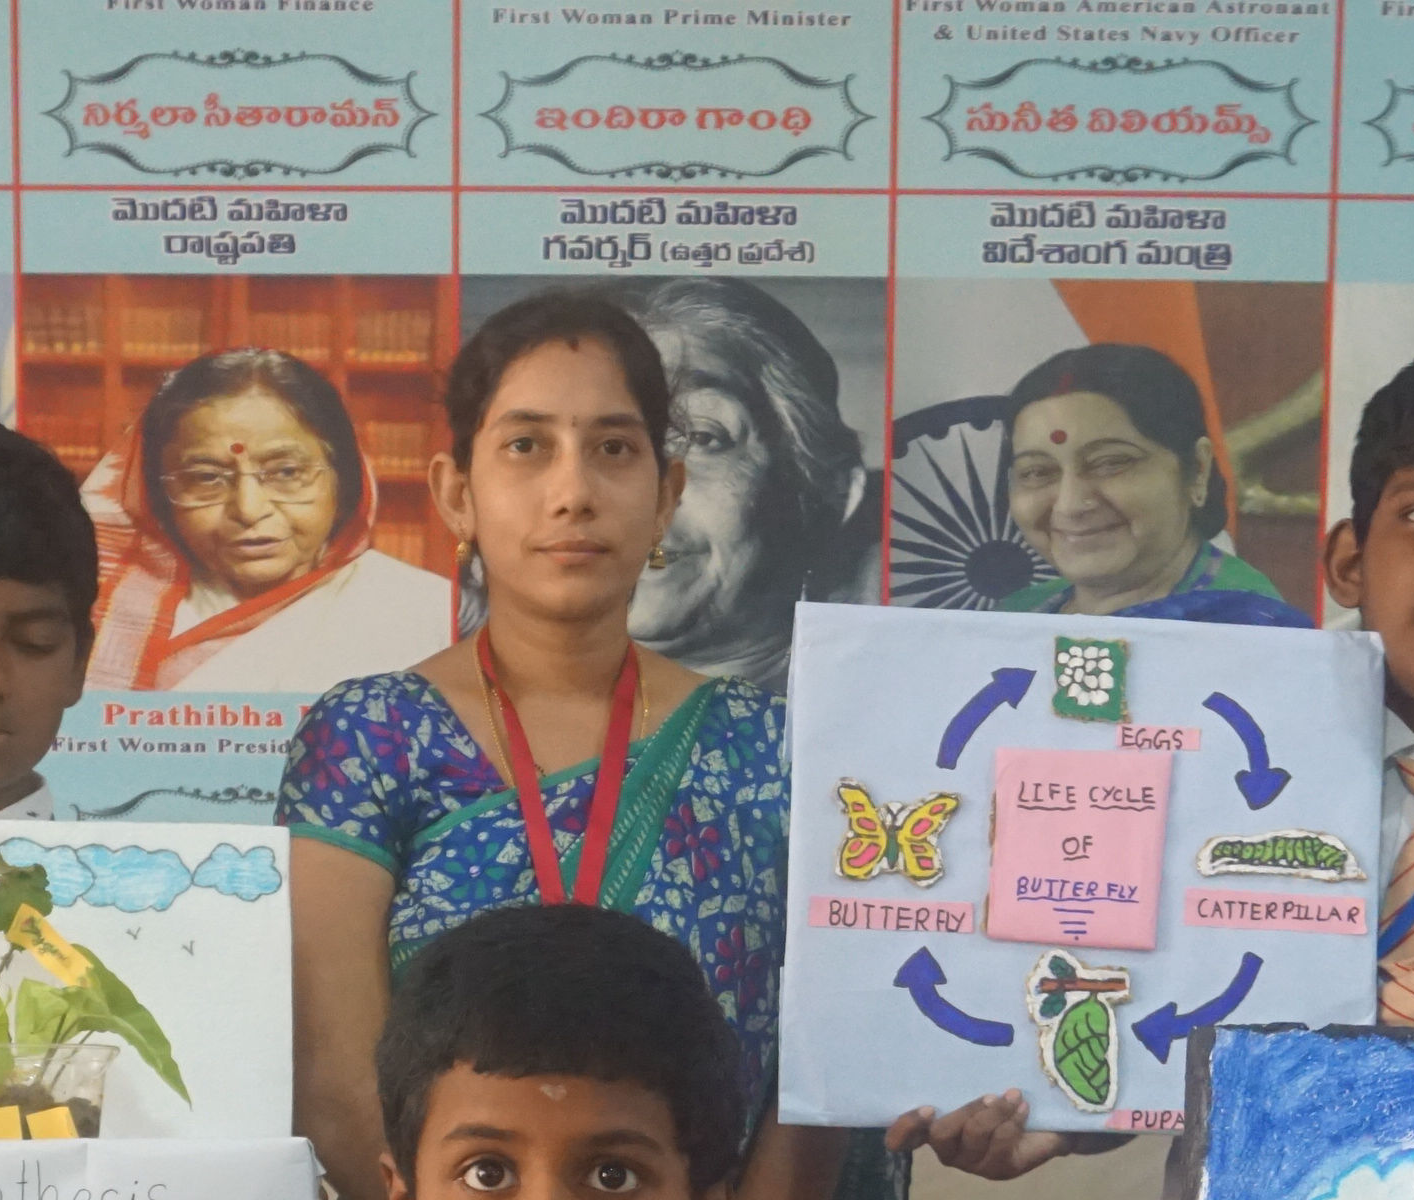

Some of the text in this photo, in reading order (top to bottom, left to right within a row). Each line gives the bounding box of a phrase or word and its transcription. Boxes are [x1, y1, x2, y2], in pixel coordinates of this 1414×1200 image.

[492, 9, 851, 27] First Woman Prime Minister
[905, 0, 1197, 15] First Woman American
[934, 25, 1300, 45] & United States Navy Officer
[83, 93, 400, 139] నిర్మలా సీతారామన్
[535, 107, 685, 132] ఇందిరా
[966, 101, 1078, 133] సునీత
[112, 195, 347, 222] మొదటి మహిళా
[560, 197, 797, 226] మొదటి మహిళా
[990, 200, 1226, 230] మొదటి మహిళా
[104, 704, 283, 728] Prathibha
[52, 737, 290, 754] First Woman Presid
[1120, 726, 1184, 750] EGGS
[1017, 781, 1155, 804] LIFE CYCLE
[1062, 836, 1094, 856] OF
[1198, 898, 1361, 925] CATTERPILLAR
